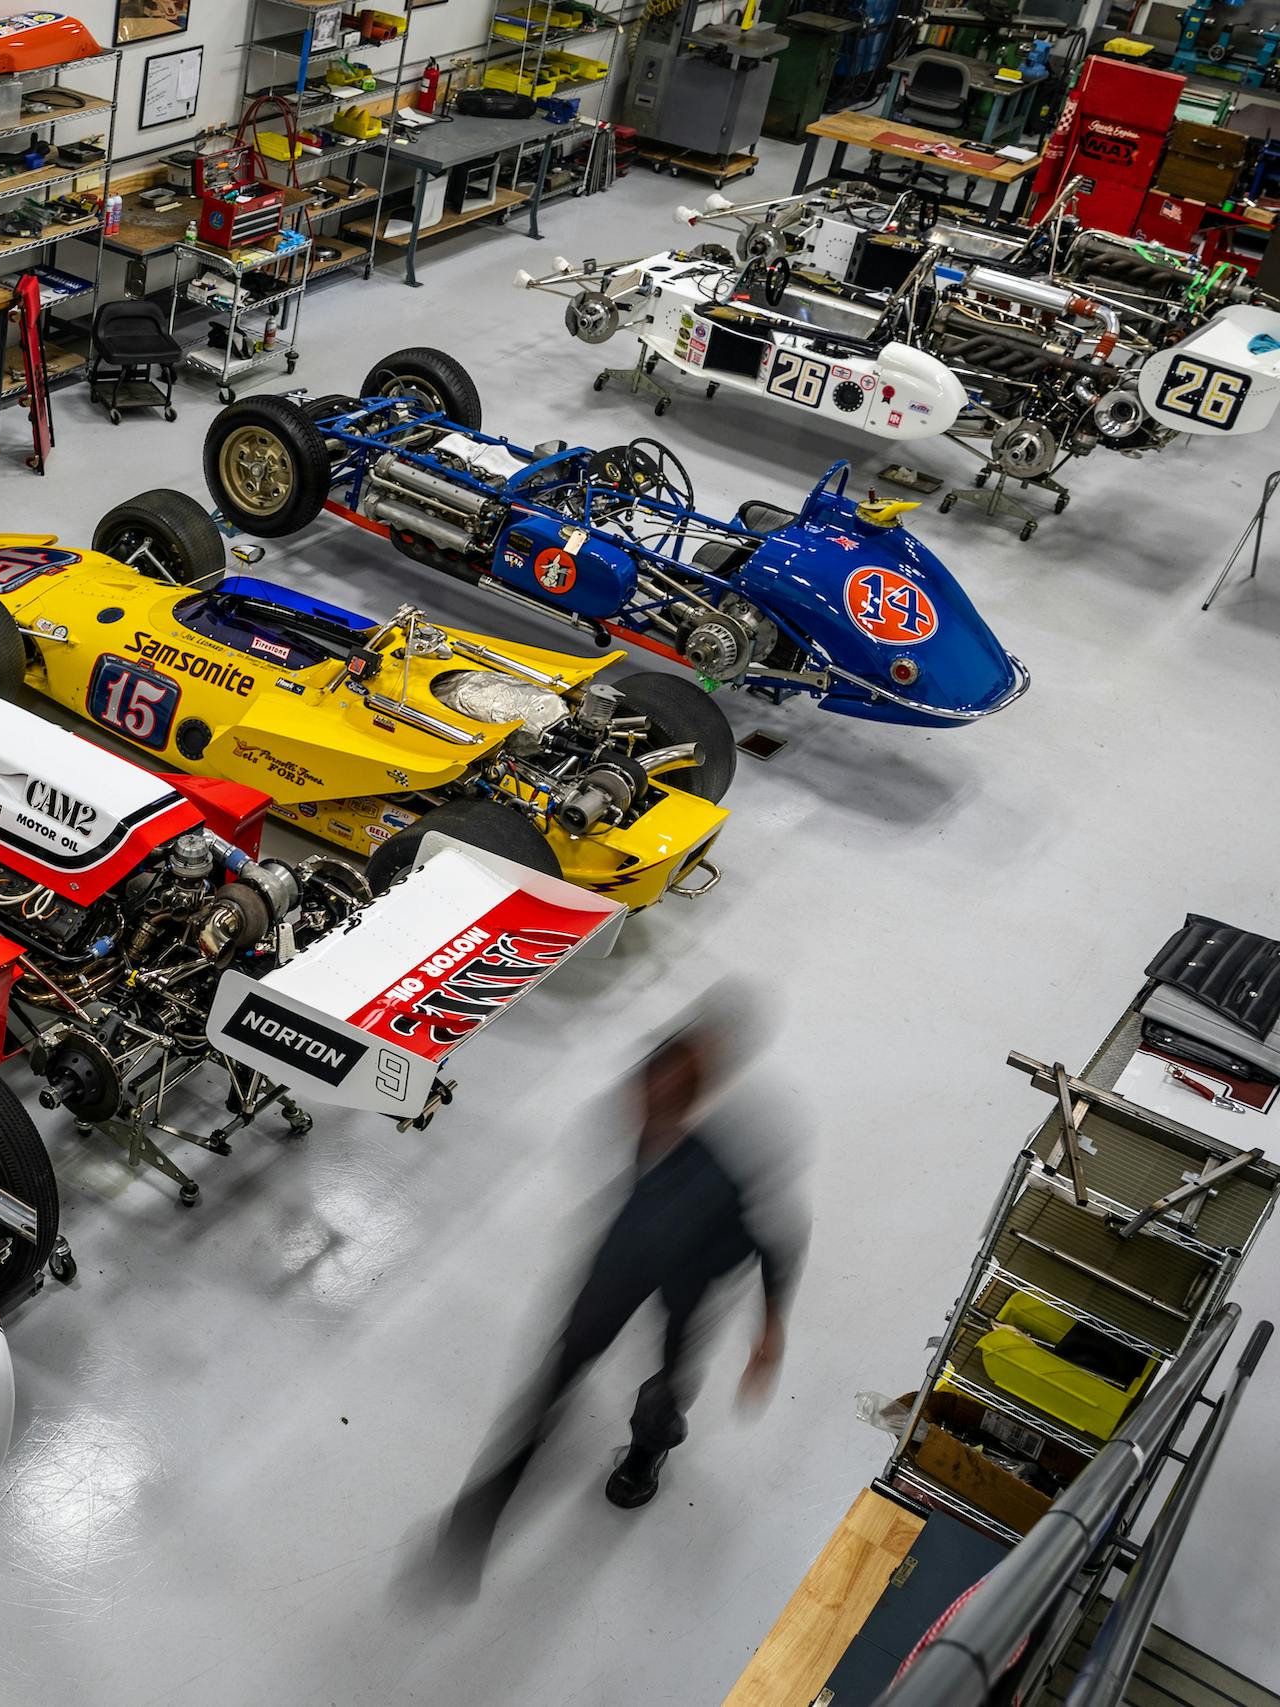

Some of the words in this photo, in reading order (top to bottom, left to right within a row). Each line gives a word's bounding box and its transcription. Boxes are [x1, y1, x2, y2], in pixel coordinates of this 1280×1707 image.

[770, 352, 828, 407] 26
[1162, 360, 1244, 424] 26
[858, 572, 931, 636] 14
[181, 631, 195, 643] JOE
[254, 638, 288, 658] Firestone
[124, 631, 255, 697] Samsonite
[347, 681, 366, 696] Ford
[102, 671, 167, 739] 15
[267, 763, 305, 786] FORD
[16, 813, 56, 841] MOTOR
[61, 837, 79, 853] OIL
[26, 779, 97, 837] CAM2
[369, 826, 391, 840] BELL
[418, 926, 491, 977] MOTOR
[384, 977, 425, 1002] OIL
[240, 1009, 347, 1069] NORTON
[375, 1047, 410, 1102] 9
